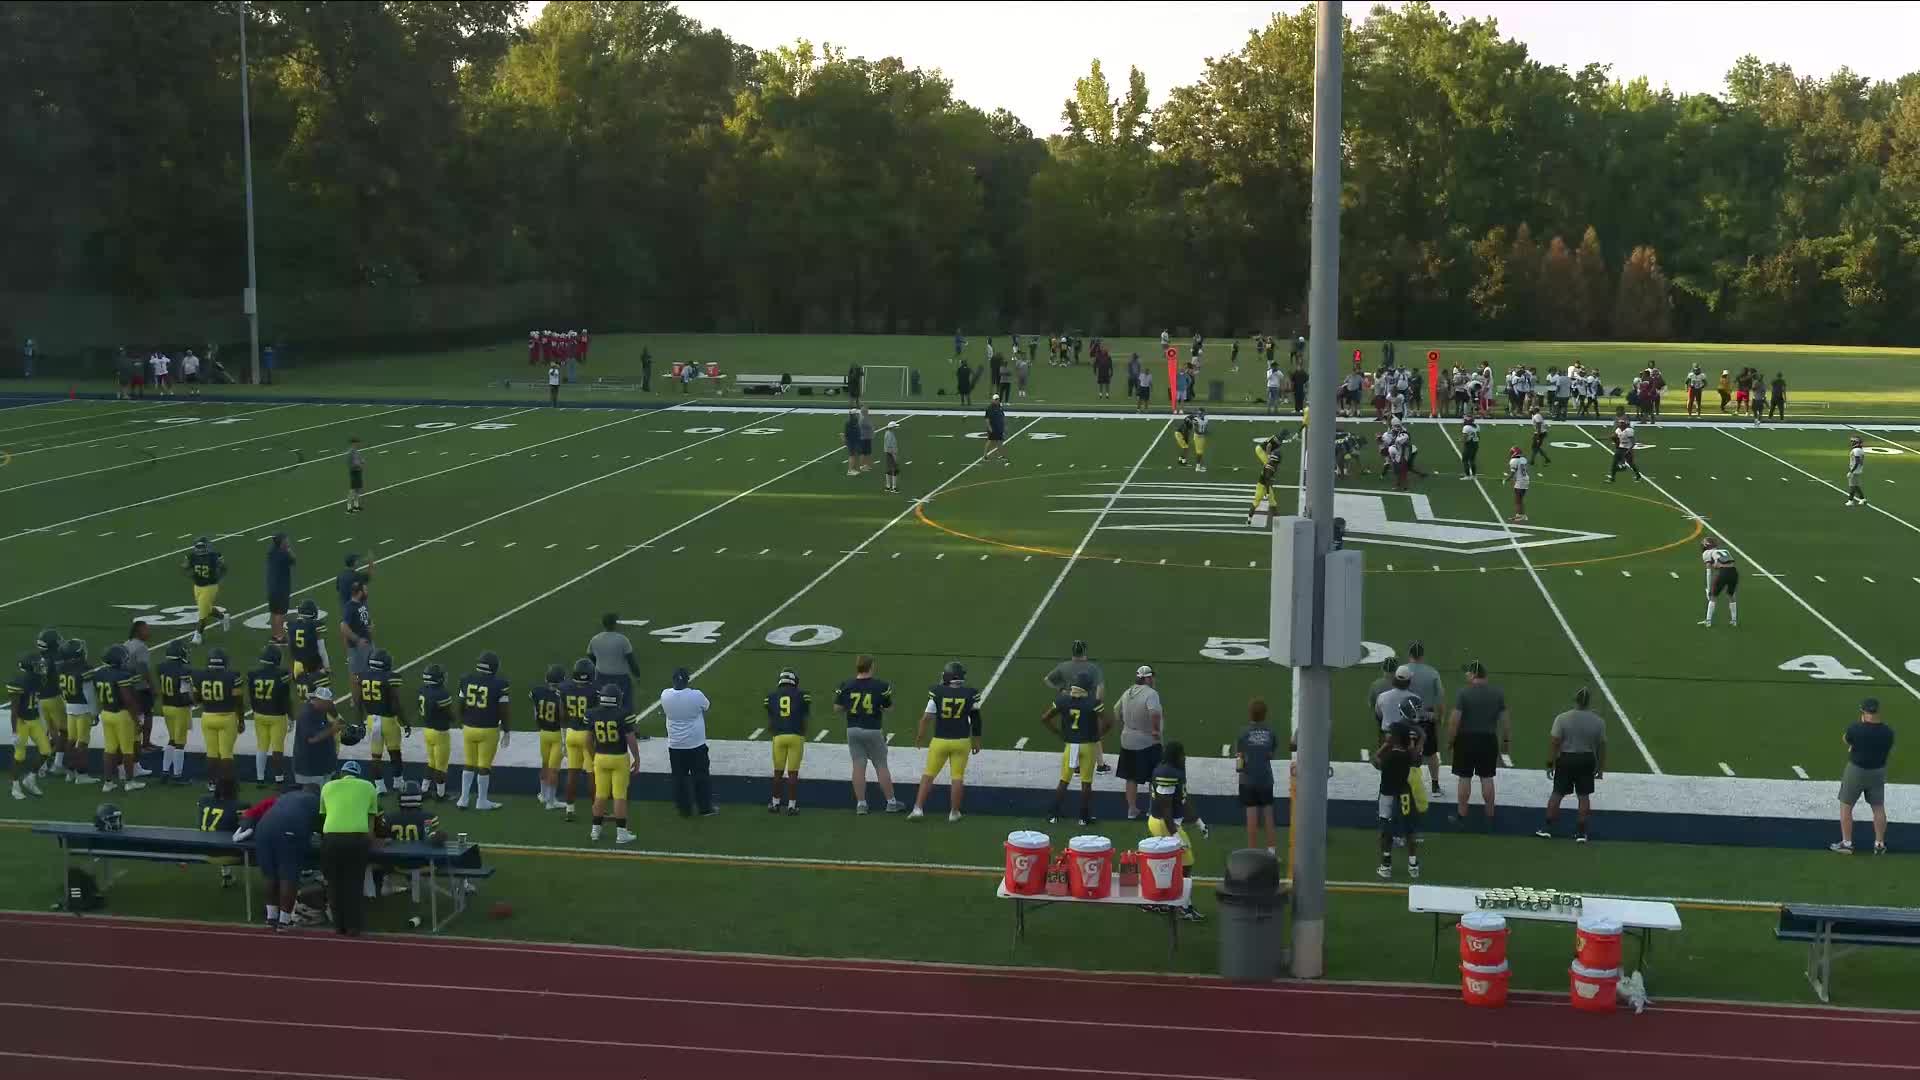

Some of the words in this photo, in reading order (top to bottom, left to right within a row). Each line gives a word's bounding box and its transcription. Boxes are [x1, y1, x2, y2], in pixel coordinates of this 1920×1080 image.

[295, 629, 305, 648] 5
[97, 681, 115, 704] 72
[201, 680, 225, 701] 60
[254, 679, 275, 700] 27
[362, 679, 383, 701] 25
[466, 683, 489, 708] 53
[537, 699, 556, 722] 18
[566, 695, 588, 718] 58
[779, 696, 791, 717] 9
[849, 692, 873, 714] 74
[941, 697, 966, 719] 57
[1069, 708, 1081, 729] 7
[594, 720, 619, 743] 66
[201, 807, 224, 832] 17
